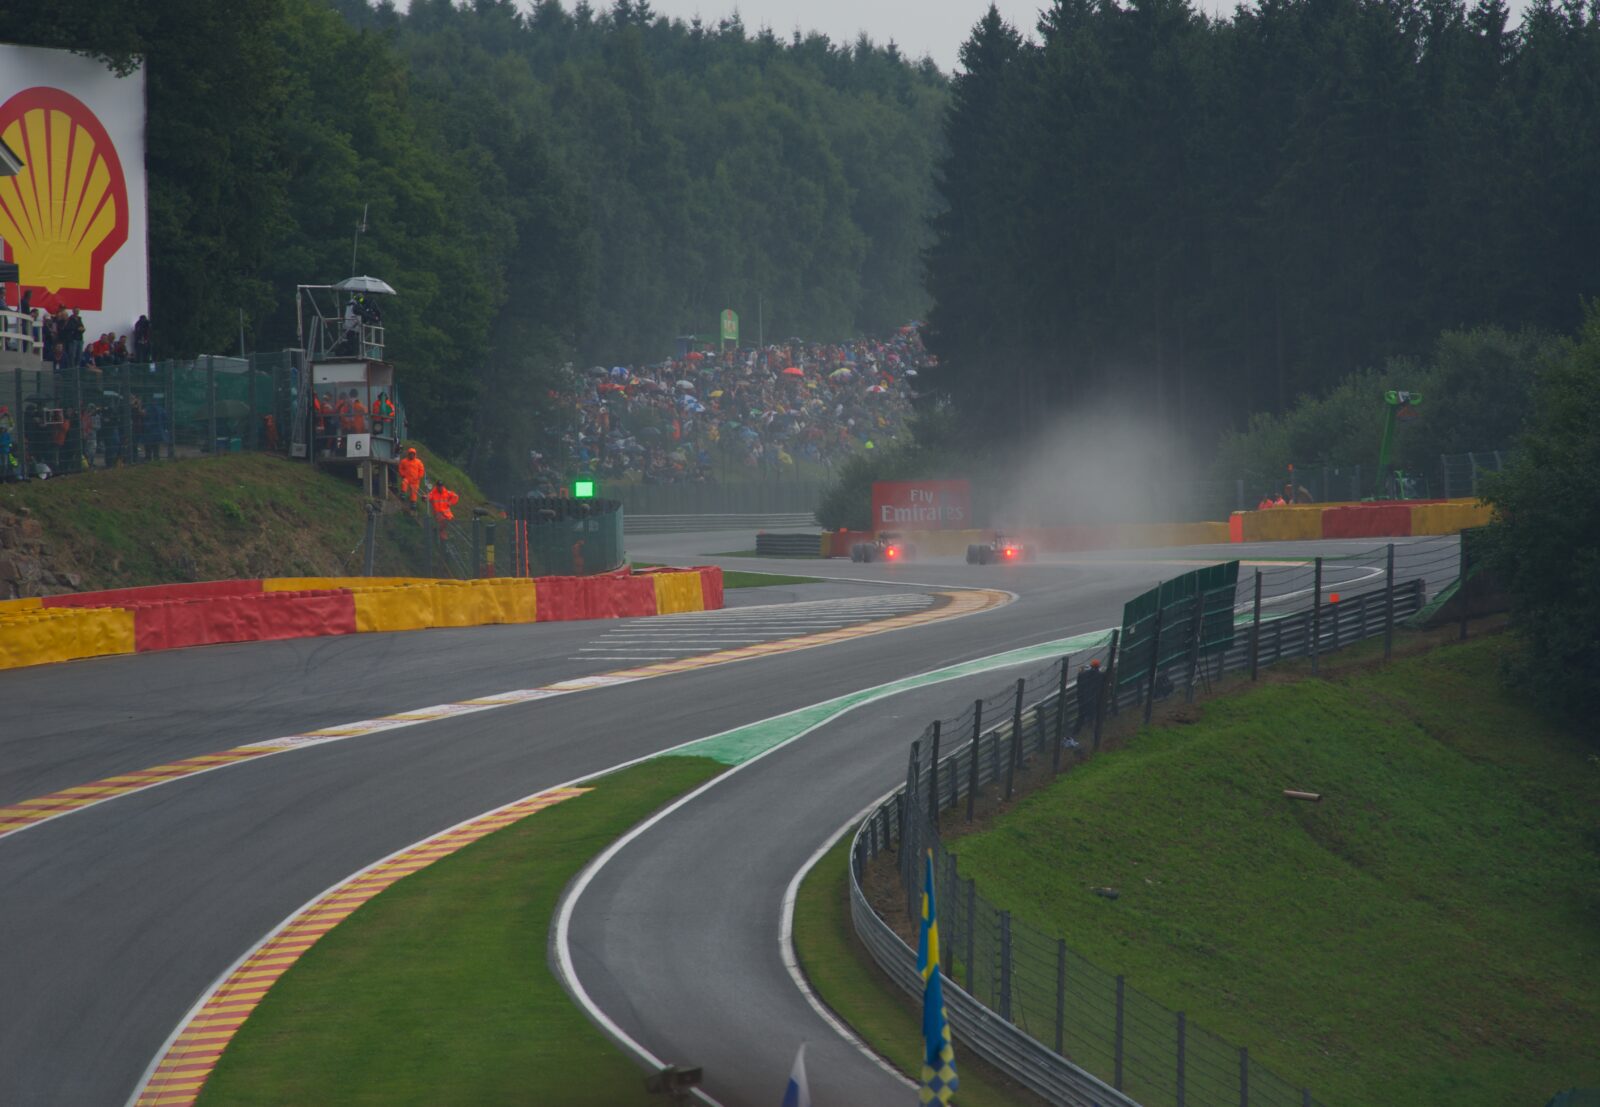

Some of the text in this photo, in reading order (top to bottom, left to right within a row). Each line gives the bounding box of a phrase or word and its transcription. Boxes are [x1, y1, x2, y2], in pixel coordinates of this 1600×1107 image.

[355, 440, 362, 451] 6
[911, 489, 934, 504] Fly
[881, 504, 964, 522] Emirates
